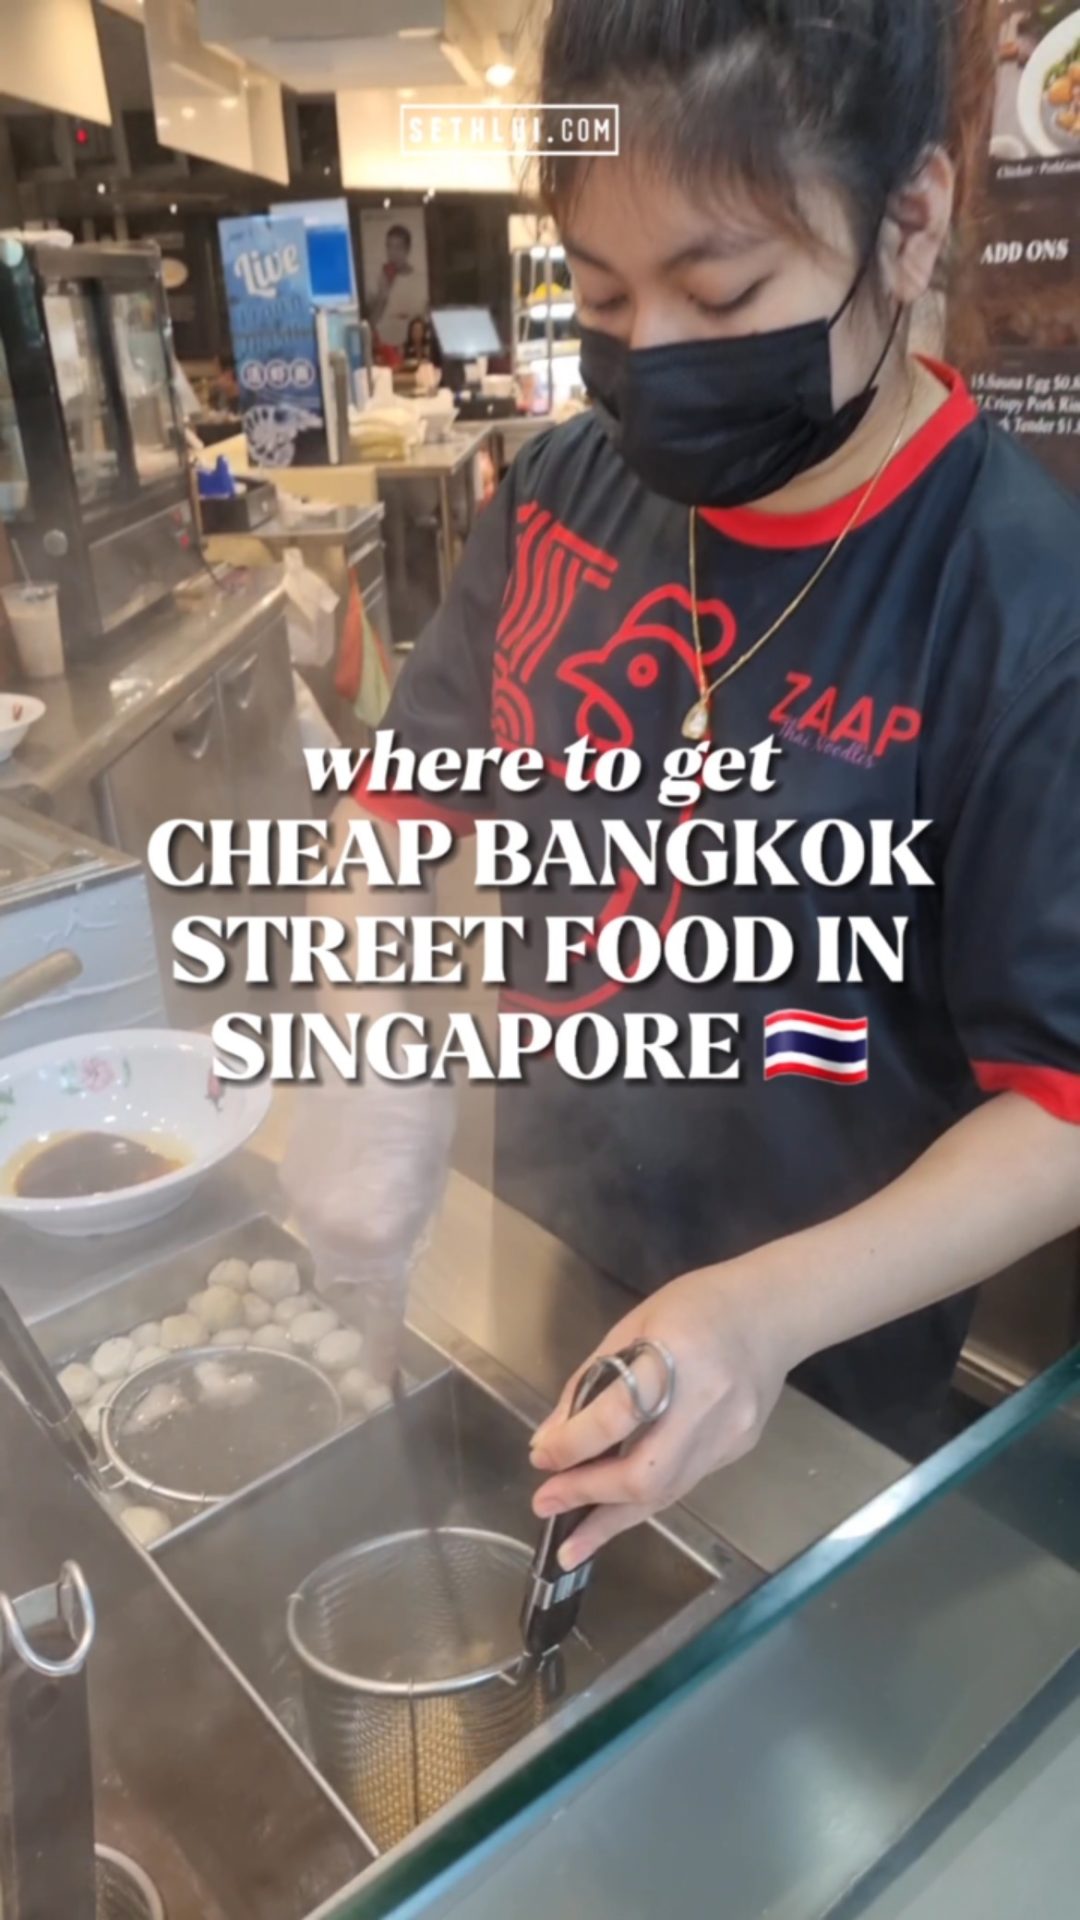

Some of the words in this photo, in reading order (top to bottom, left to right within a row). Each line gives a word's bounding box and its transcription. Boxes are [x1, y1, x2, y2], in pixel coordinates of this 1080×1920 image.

[981, 242, 1023, 264] ADD
[1026, 238, 1069, 262] ONS
[234, 246, 299, 298] Live
[1026, 373, 1051, 394] Egg
[1027, 395, 1055, 412] Pork
[1014, 416, 1055, 433] Tender
[768, 671, 923, 757] ZAAP
